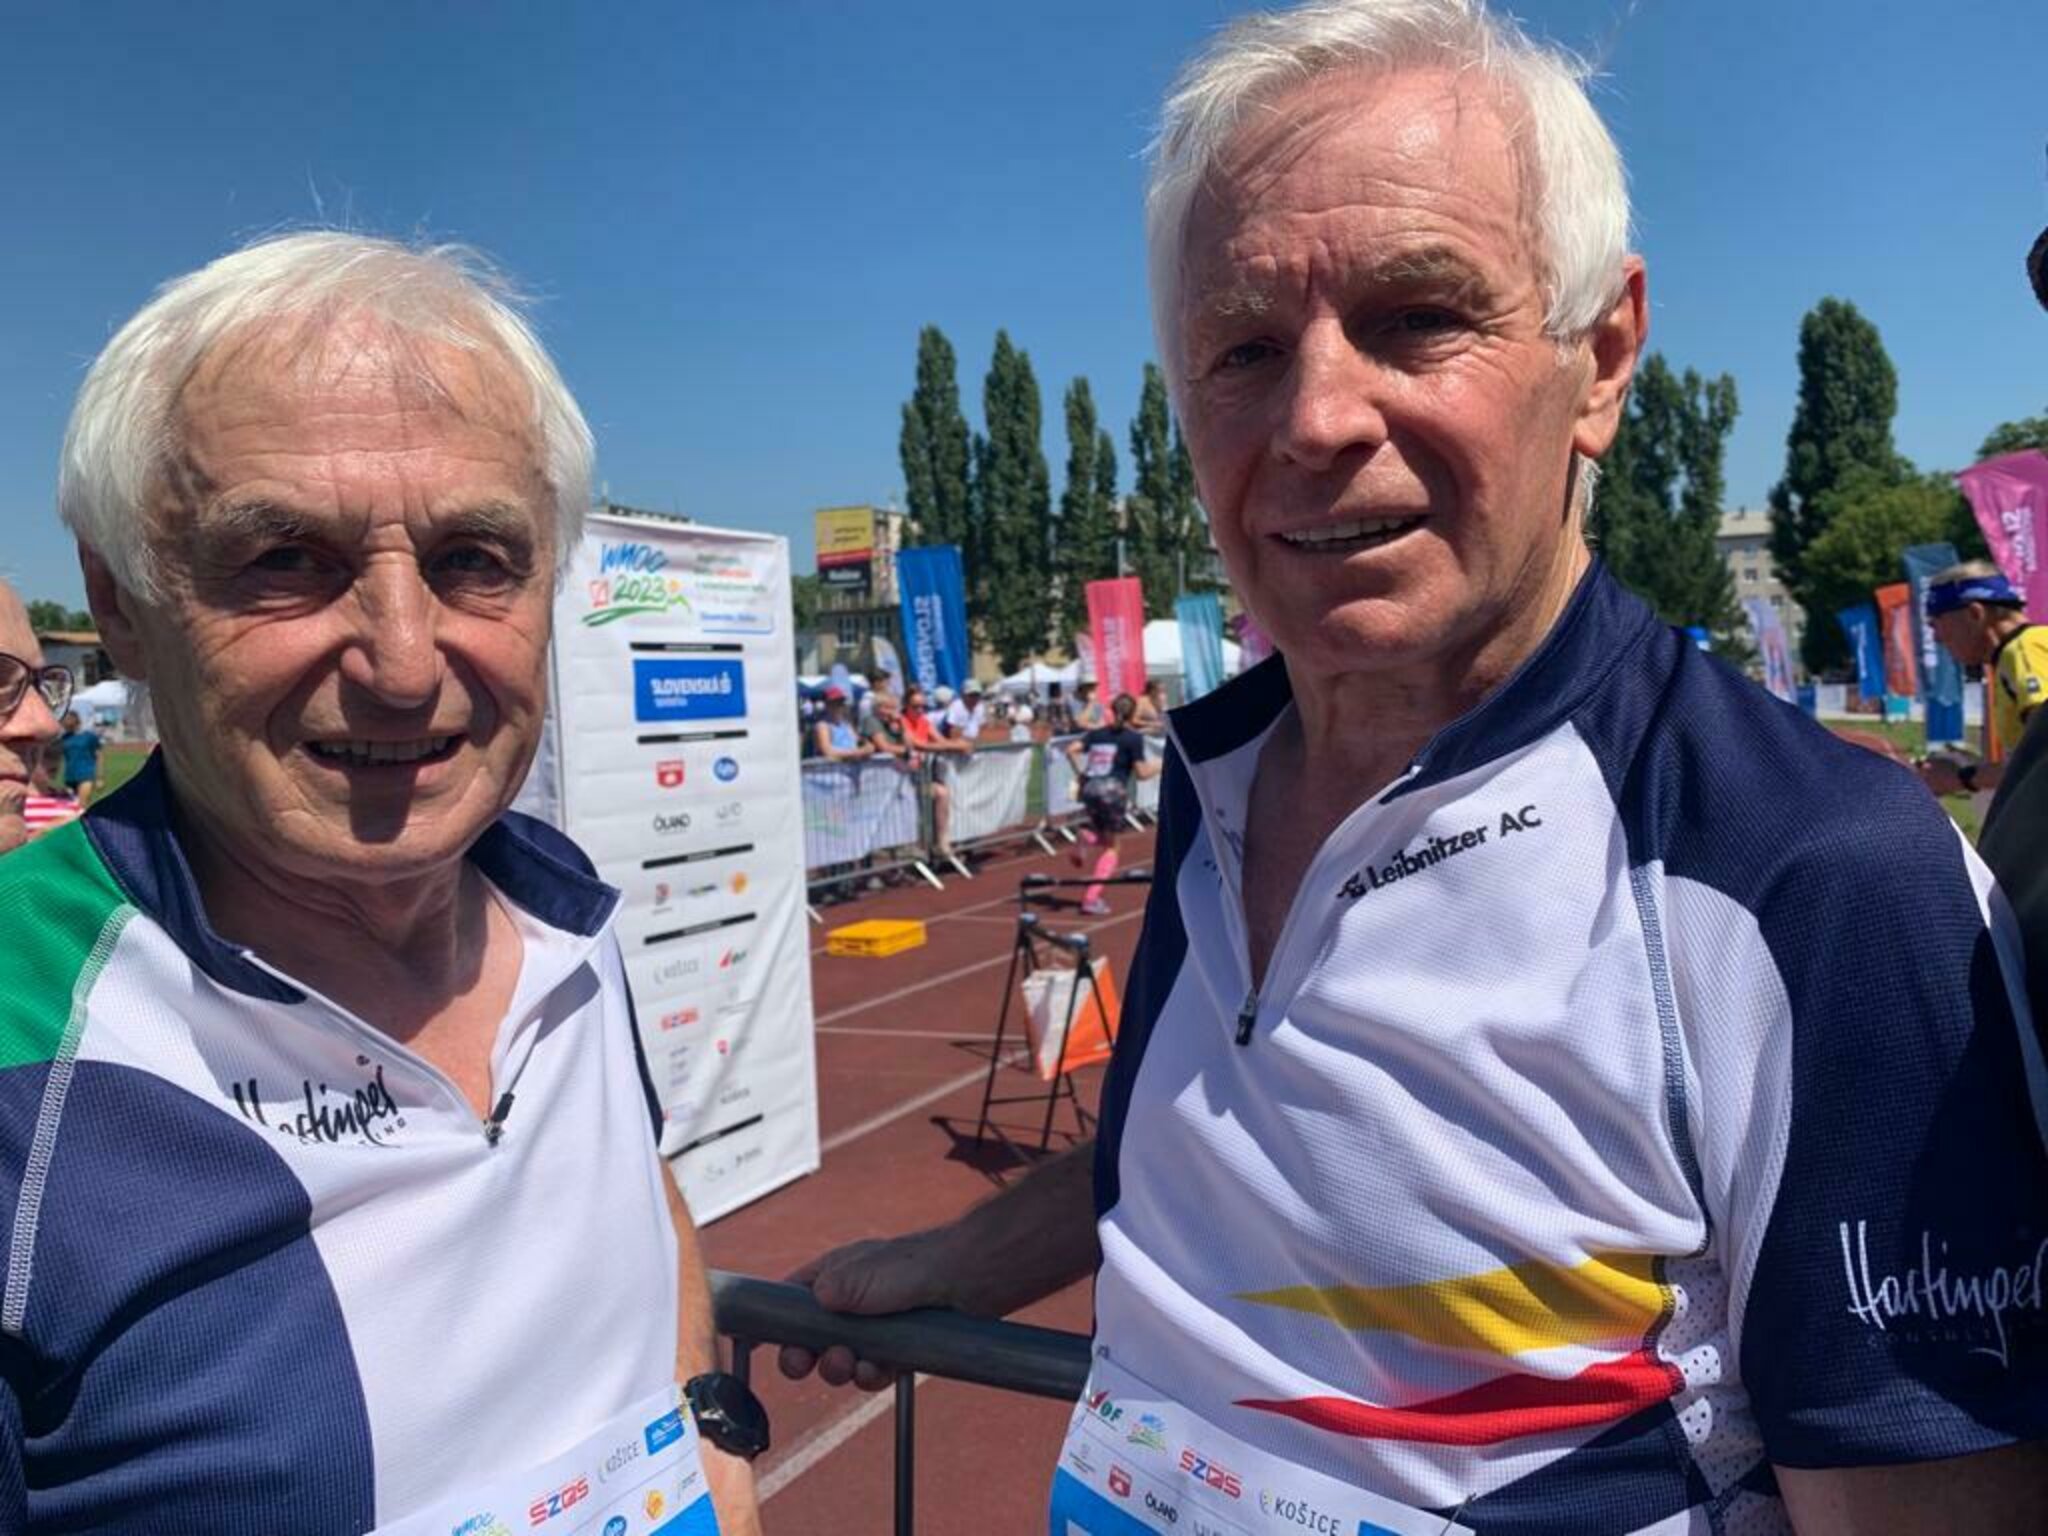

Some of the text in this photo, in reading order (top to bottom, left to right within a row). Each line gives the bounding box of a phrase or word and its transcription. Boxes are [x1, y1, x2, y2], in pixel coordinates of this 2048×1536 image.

[600, 543, 669, 573] WMOC
[613, 575, 667, 601] 2023
[1366, 804, 1543, 889] Leibnitzer AC
[1274, 1496, 1341, 1536] KOŠICE
